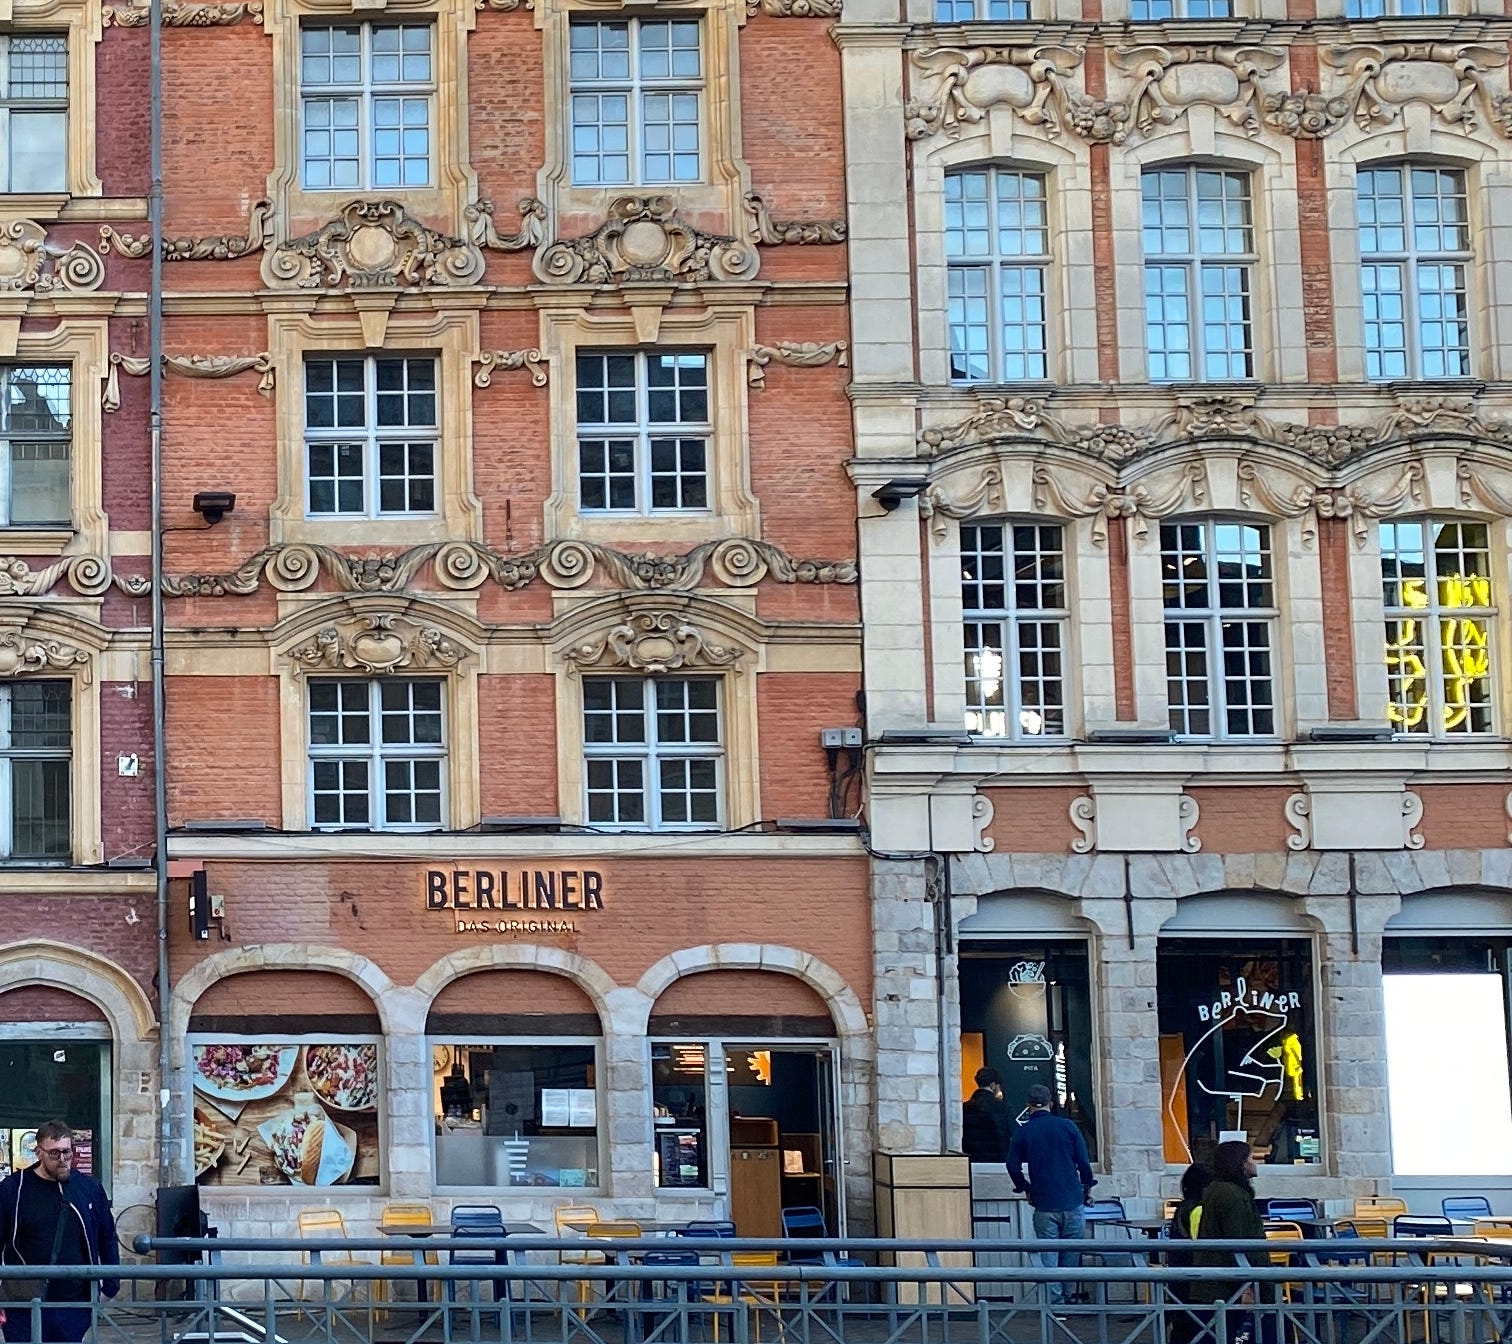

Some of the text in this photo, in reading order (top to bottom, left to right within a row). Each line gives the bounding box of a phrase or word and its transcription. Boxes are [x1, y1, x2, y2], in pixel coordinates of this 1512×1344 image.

[427, 870, 604, 910] BERLINER
[457, 919, 581, 933] DAS ORIGINAL
